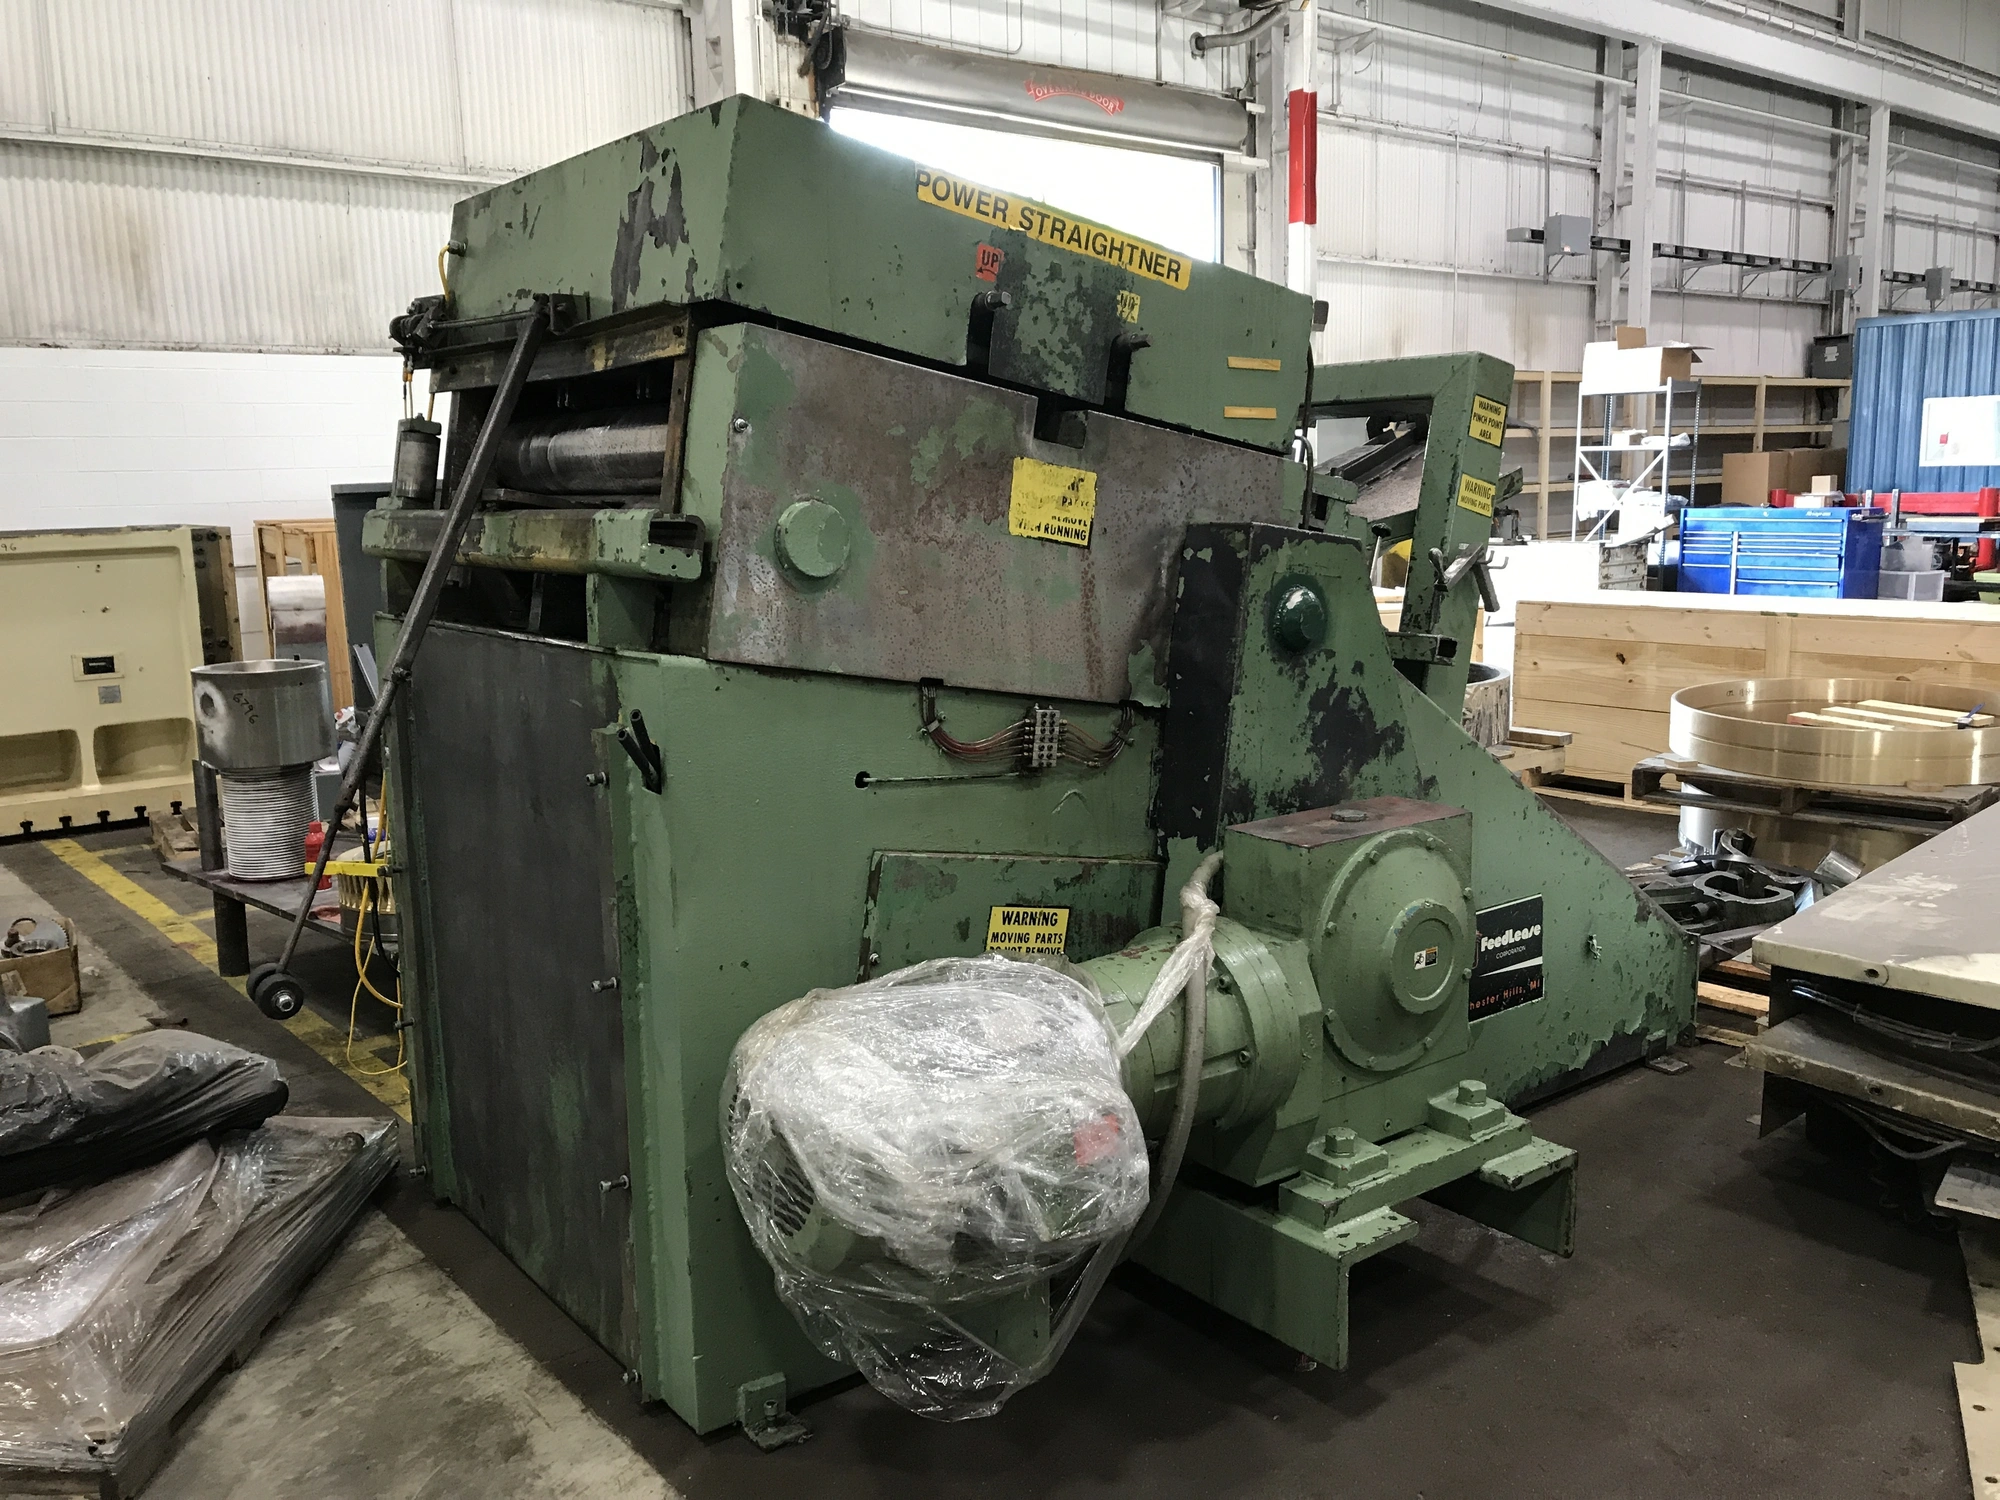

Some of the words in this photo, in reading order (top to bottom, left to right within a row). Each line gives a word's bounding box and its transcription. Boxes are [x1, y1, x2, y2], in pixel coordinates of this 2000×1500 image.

[1089, 90, 1114, 112] DOOR
[916, 170, 1009, 222] POWER
[1018, 206, 1182, 283] STRAIGHTNER
[981, 250, 999, 268] UP
[1478, 400, 1502, 416] WARNING
[1472, 412, 1488, 425] PINCH
[1487, 417, 1503, 429] POINT
[1479, 429, 1492, 440] AREA
[1464, 479, 1492, 500] WARNING
[1460, 495, 1478, 507] MOVING
[1477, 501, 1491, 512] PARTS
[1043, 522, 1087, 541] RUNNING
[232, 692, 259, 725] 6796
[1002, 910, 1059, 927] WARNING
[990, 931, 1030, 944] MOVING
[1034, 932, 1063, 944] PARTS
[1480, 924, 1541, 953] FeedLease
[1495, 945, 1527, 960] CORPORATION
[1529, 978, 1541, 991] MI
